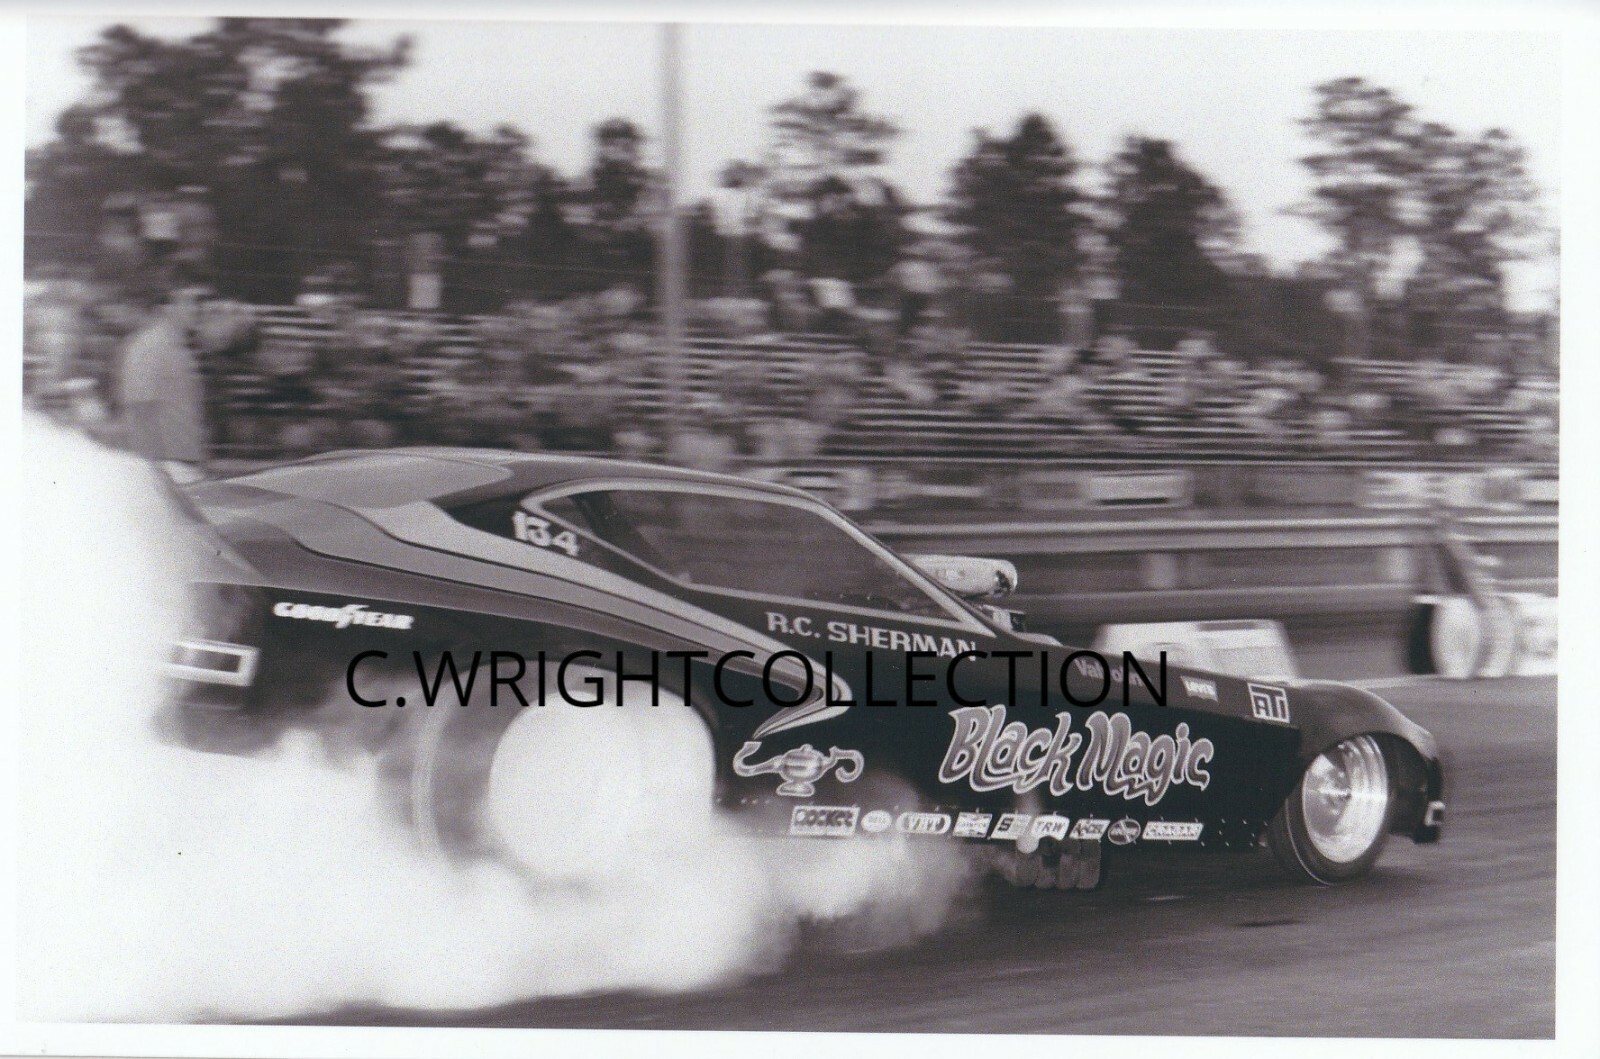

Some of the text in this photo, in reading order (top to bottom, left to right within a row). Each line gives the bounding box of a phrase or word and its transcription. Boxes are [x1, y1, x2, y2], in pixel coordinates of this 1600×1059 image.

[766, 611, 977, 662] R.C. SHERMAN
[938, 703, 1214, 806] Black Magic
[1036, 820, 1066, 833] TRW
